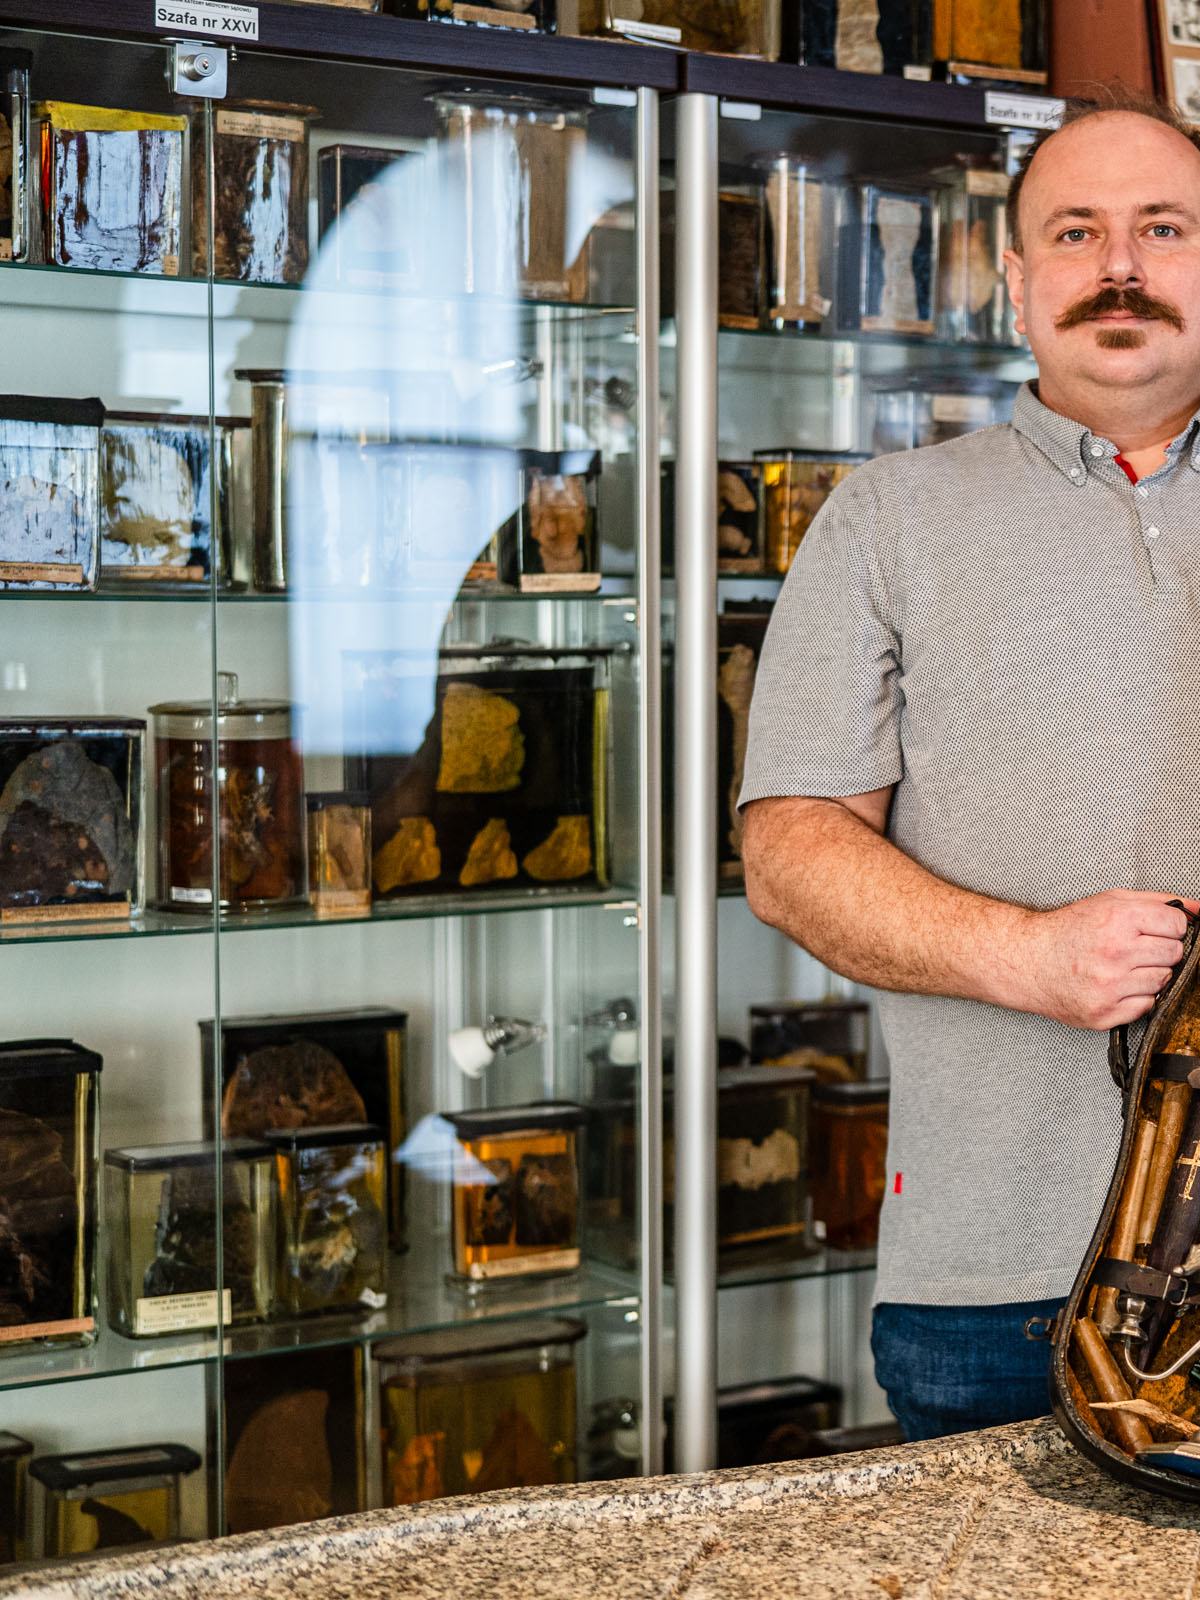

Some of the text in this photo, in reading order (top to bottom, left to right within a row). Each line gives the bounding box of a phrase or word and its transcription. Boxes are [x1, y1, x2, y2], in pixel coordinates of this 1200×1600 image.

[157, 8, 256, 34] Szafa nr XXVI
